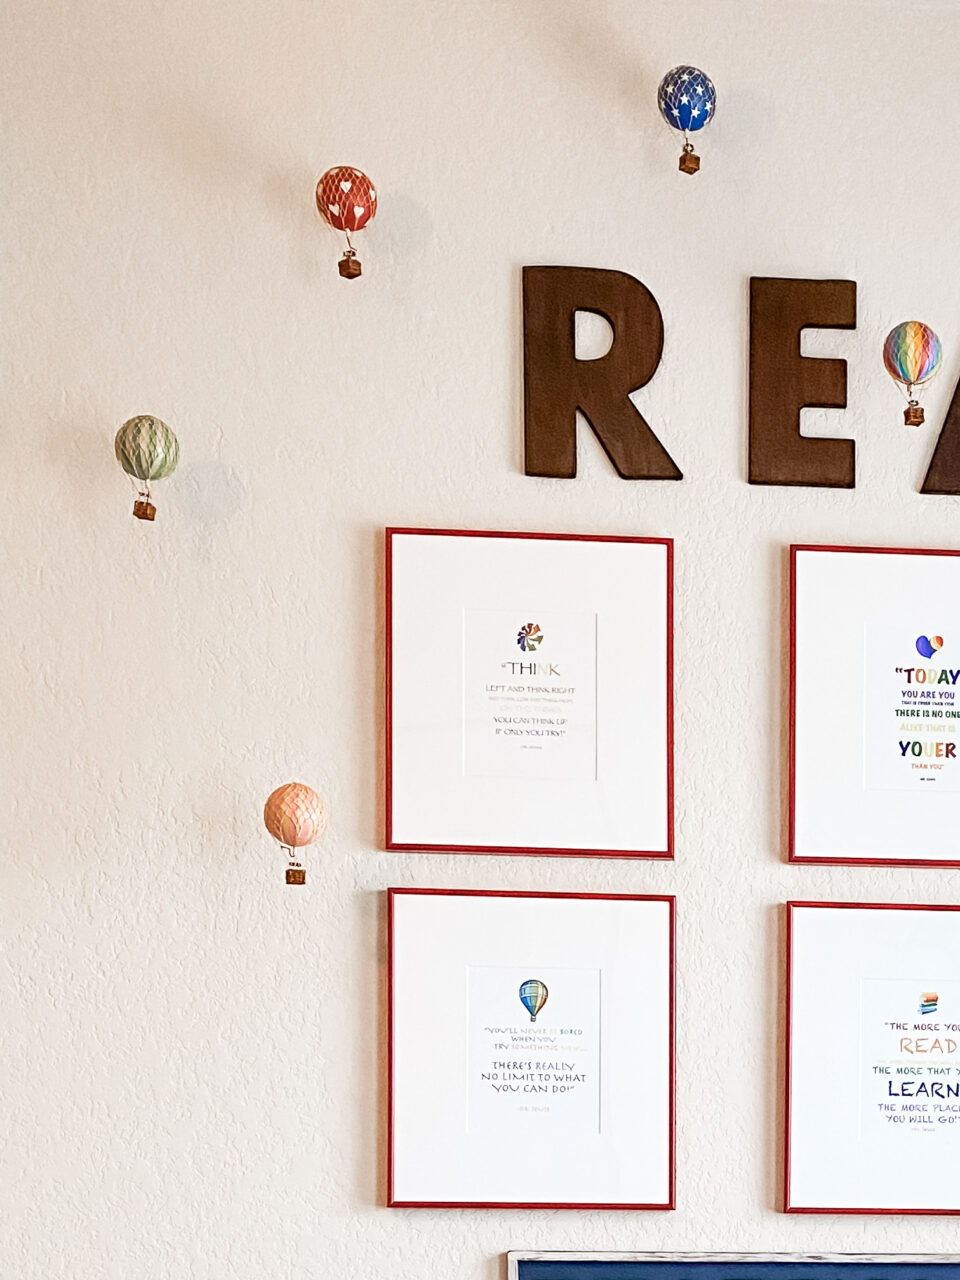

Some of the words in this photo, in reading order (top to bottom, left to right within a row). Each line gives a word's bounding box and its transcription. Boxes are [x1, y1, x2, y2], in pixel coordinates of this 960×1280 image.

[901, 690, 918, 698] YOU
[920, 690, 936, 699] ARE
[938, 691, 955, 700] YOU
[895, 709, 921, 717] THERE
[922, 709, 930, 718] IS
[931, 710, 943, 718] NO
[945, 710, 960, 719] ONE
[898, 740, 957, 759] YOUER
[560, 1028, 583, 1036] BORED
[913, 1023, 940, 1032] MORE
[900, 1037, 958, 1055] READ
[492, 1061, 532, 1071] THERE'S
[535, 1062, 576, 1072] REALLY
[872, 1066, 891, 1075] THE
[896, 1067, 923, 1075] MORE
[927, 1067, 952, 1076] THAT
[481, 1072, 499, 1081] NO
[502, 1073, 535, 1082] LIMIT
[537, 1074, 551, 1082] TO
[553, 1074, 587, 1083] WHAT
[491, 1084, 520, 1093] YOU
[523, 1084, 548, 1094] CAN
[888, 1080, 960, 1099] LEARN
[877, 1103, 897, 1112] THE
[901, 1103, 929, 1113] MORE
[885, 1114, 906, 1124] YOU
[909, 1114, 934, 1124] WILL
